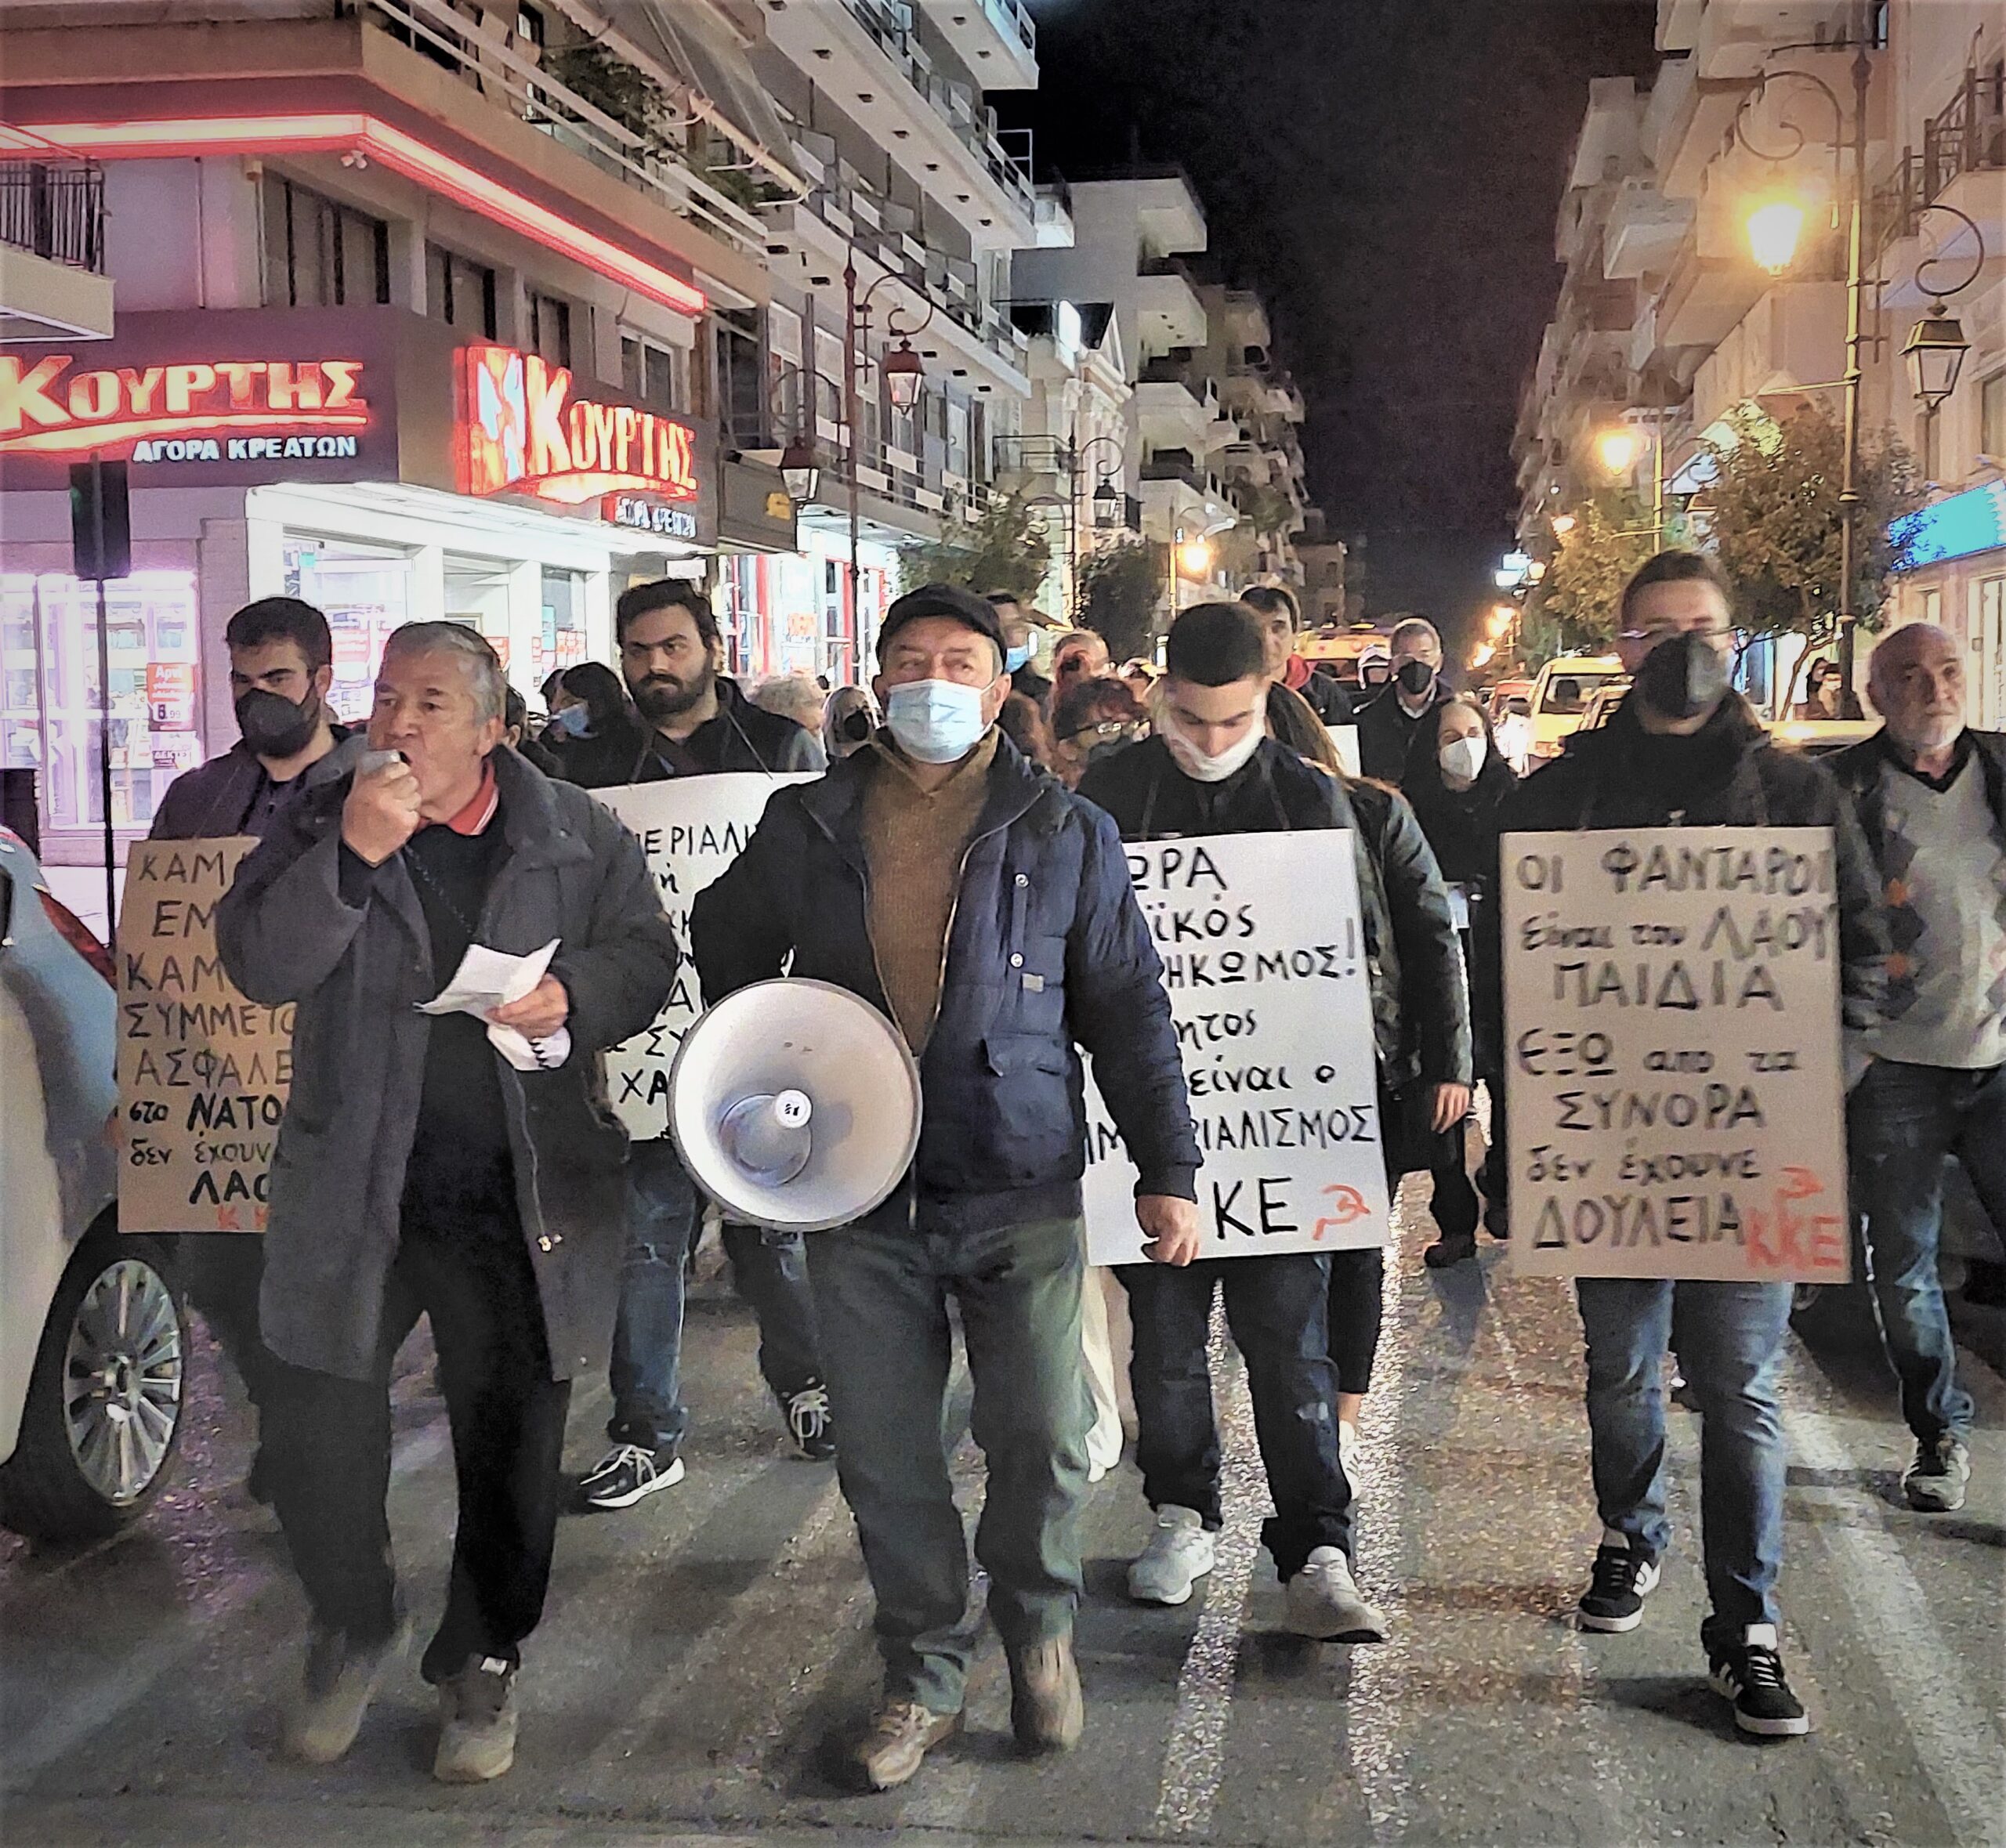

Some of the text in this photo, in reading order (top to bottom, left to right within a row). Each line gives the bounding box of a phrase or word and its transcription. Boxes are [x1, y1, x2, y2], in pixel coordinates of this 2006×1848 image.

[0, 355, 368, 432] ΚΟΥΡΤΗΣ
[526, 354, 697, 490] ΚΟΥΡΤΗΣ
[132, 436, 357, 463] ΑΓΟΡΑ ΚΡΕΑΤΩΝ
[139, 850, 245, 887] ΚΑΜ
[1515, 841, 1834, 896] ΟΙ ΦΑΝΤΑΡΟΙ
[1700, 903, 1838, 962] ΛΑΟΥ
[1553, 958, 1785, 1011] ΠΑΙΔΙΑ
[1189, 1054, 1336, 1097] είναι ο
[1517, 1027, 1617, 1077] ΕΞΩ
[129, 1092, 283, 1132] στο ΝΑΤΟ
[1553, 1082, 1766, 1131] ΣΥΝΟΡΑ
[130, 1137, 173, 1166] δεν
[1533, 1192, 1745, 1249] ΔΟΥΛΕΙΑ
